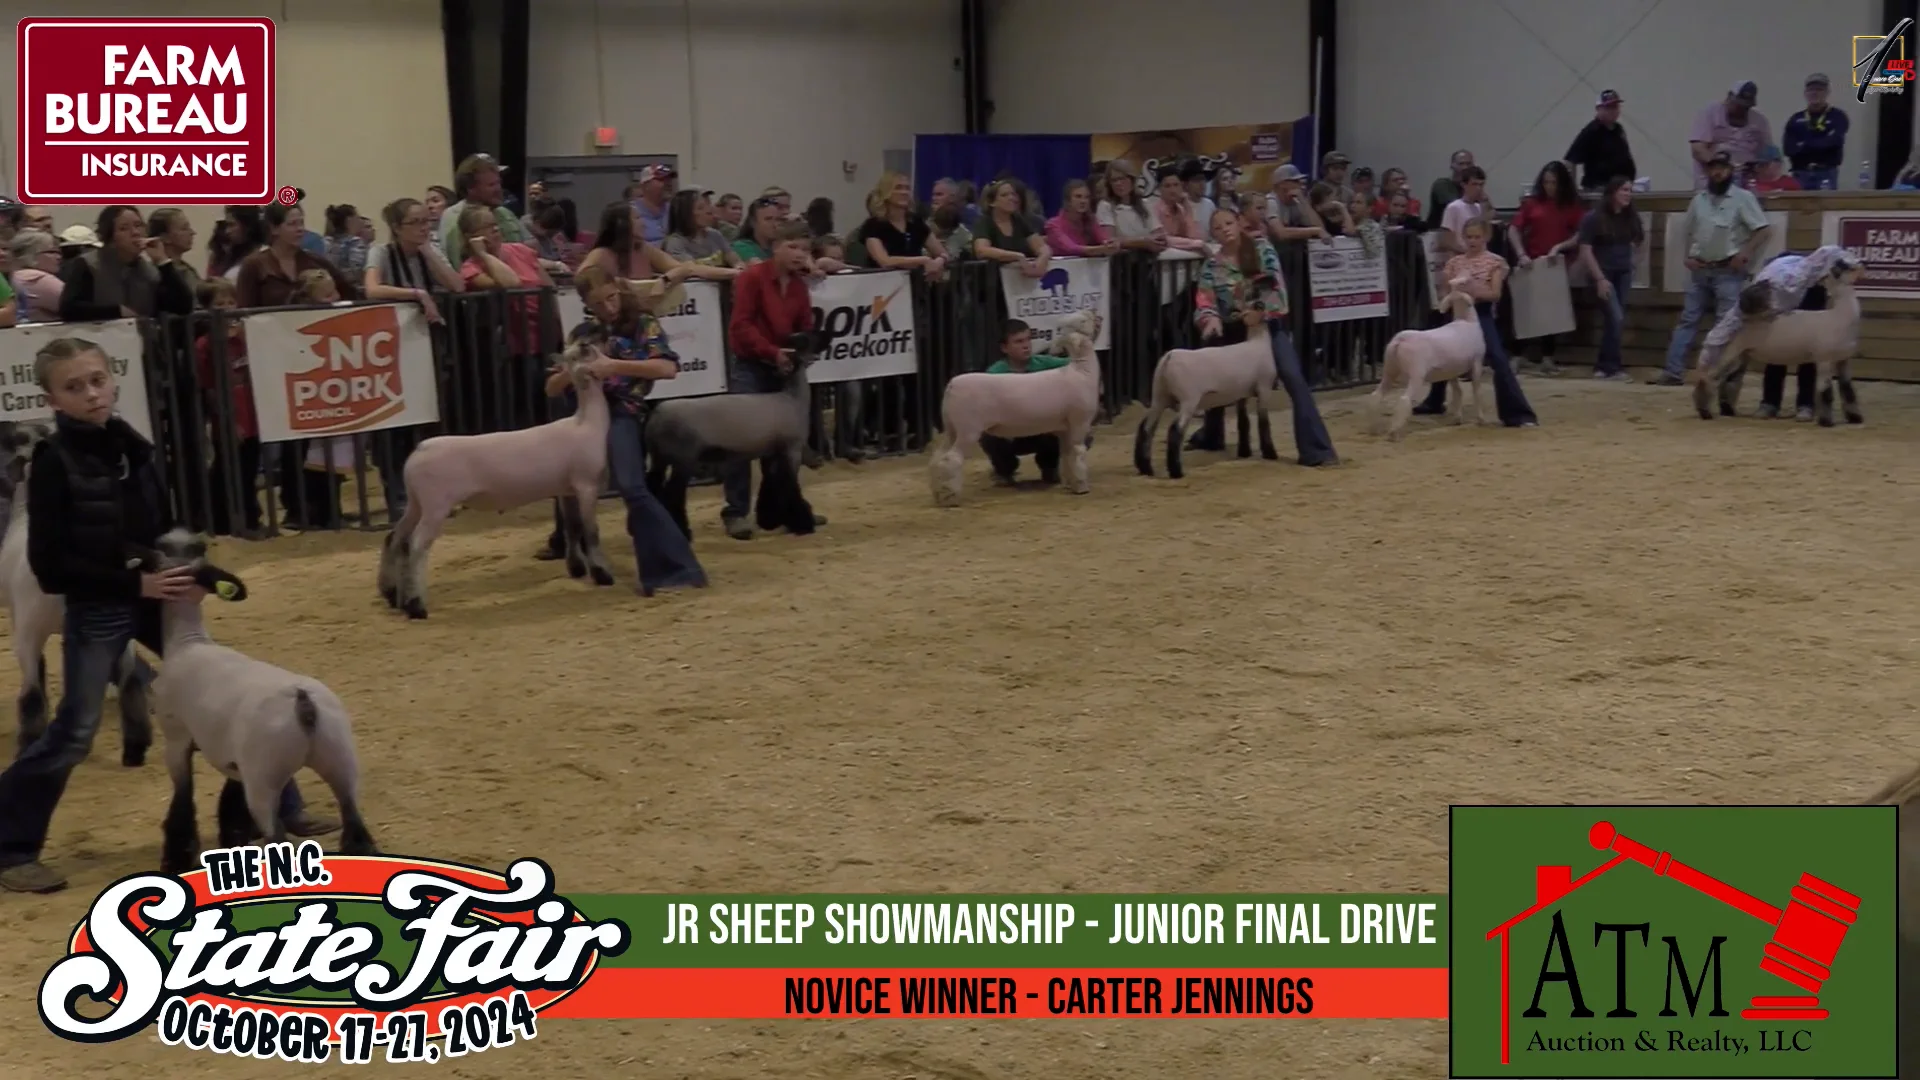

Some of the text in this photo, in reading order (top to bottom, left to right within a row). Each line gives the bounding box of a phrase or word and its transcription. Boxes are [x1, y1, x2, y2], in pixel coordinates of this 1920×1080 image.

[1866, 229, 1919, 246] FARM
[329, 330, 394, 372] NC
[293, 371, 404, 407] PORK
[297, 406, 356, 421] COUNCIL
